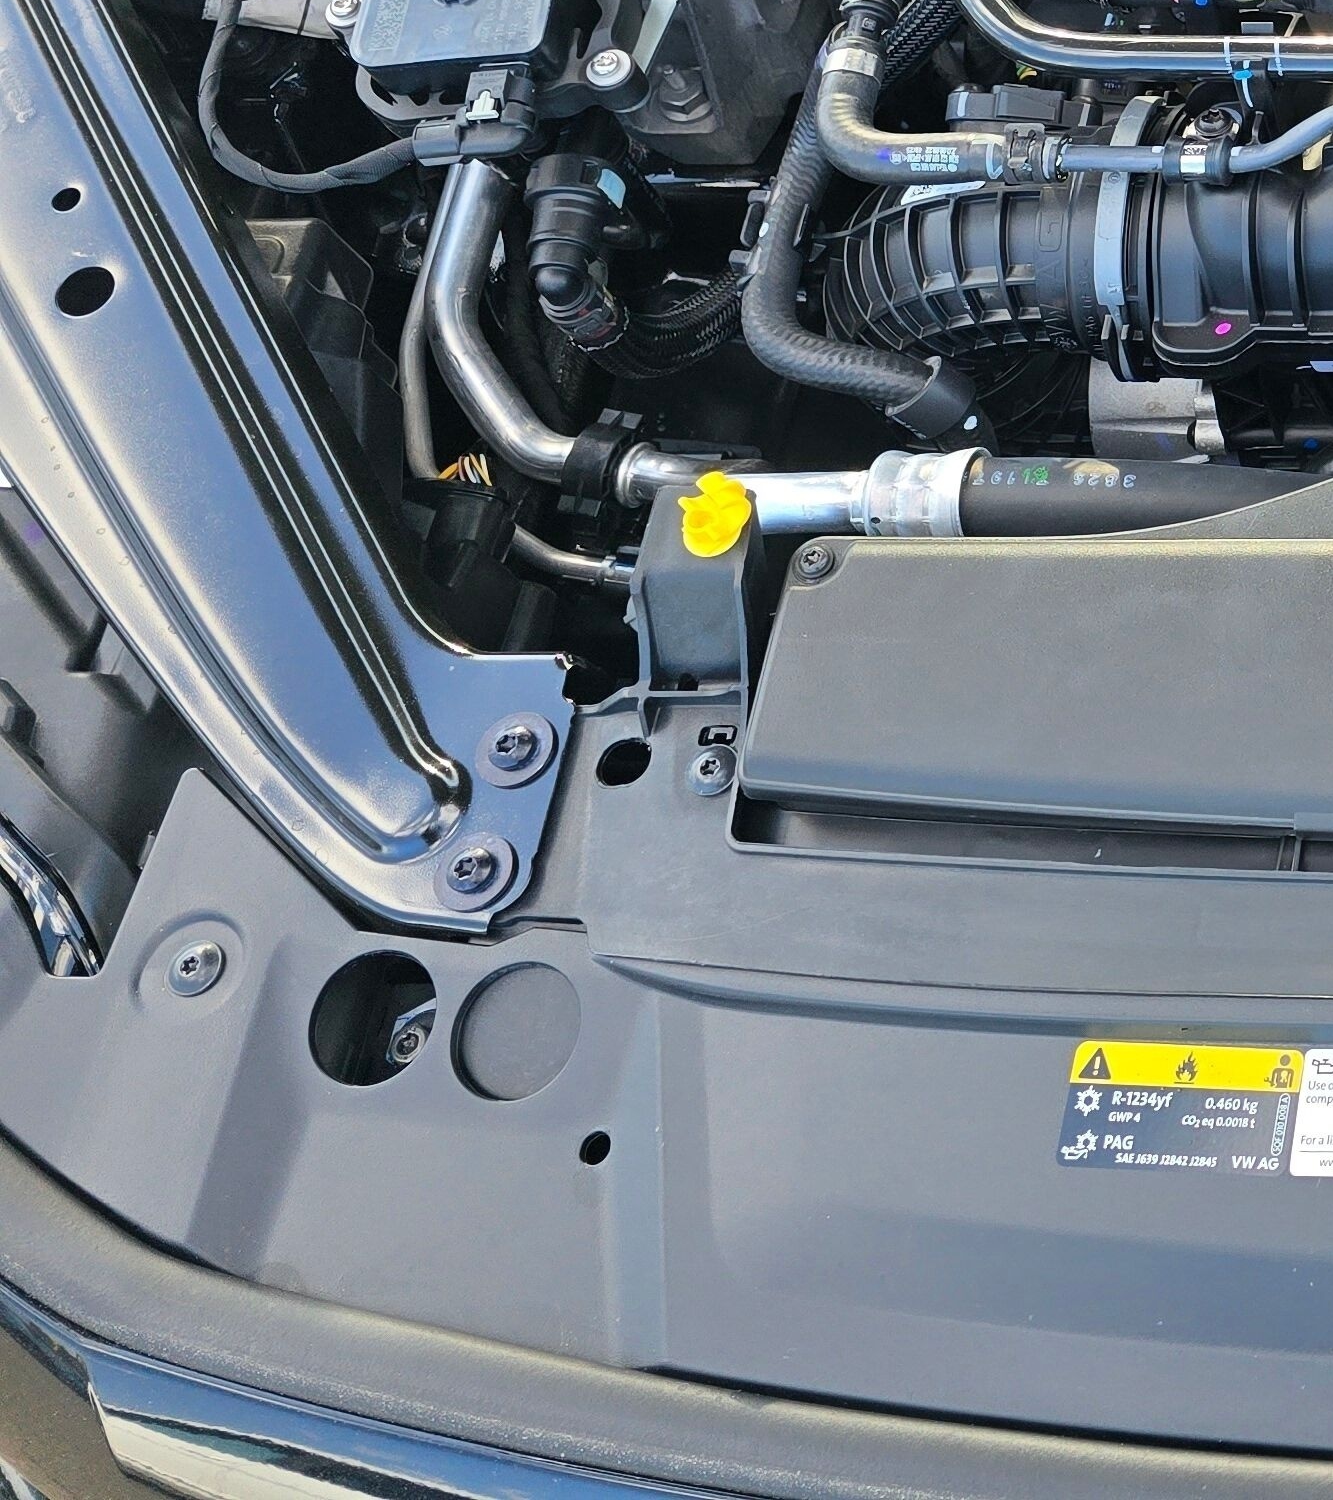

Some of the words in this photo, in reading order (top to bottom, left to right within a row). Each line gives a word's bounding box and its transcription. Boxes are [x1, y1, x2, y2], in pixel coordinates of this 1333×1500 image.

[1308, 1080, 1327, 1091] Use
[1111, 1090, 1173, 1111] R-1234yf
[1205, 1097, 1240, 1110] 0.460
[1243, 1098, 1258, 1114] kg
[1108, 1111, 1133, 1122] GWP
[1133, 1112, 1141, 1122] 4
[1202, 1117, 1215, 1129] eq
[1216, 1116, 1249, 1128] 0.0018
[1250, 1119, 1256, 1128] t
[1103, 1134, 1134, 1150] PAG
[1300, 1135, 1316, 1145] For
[1318, 1137, 1324, 1145] a
[1232, 1155, 1256, 1169] VW
[1257, 1157, 1280, 1170] AG
